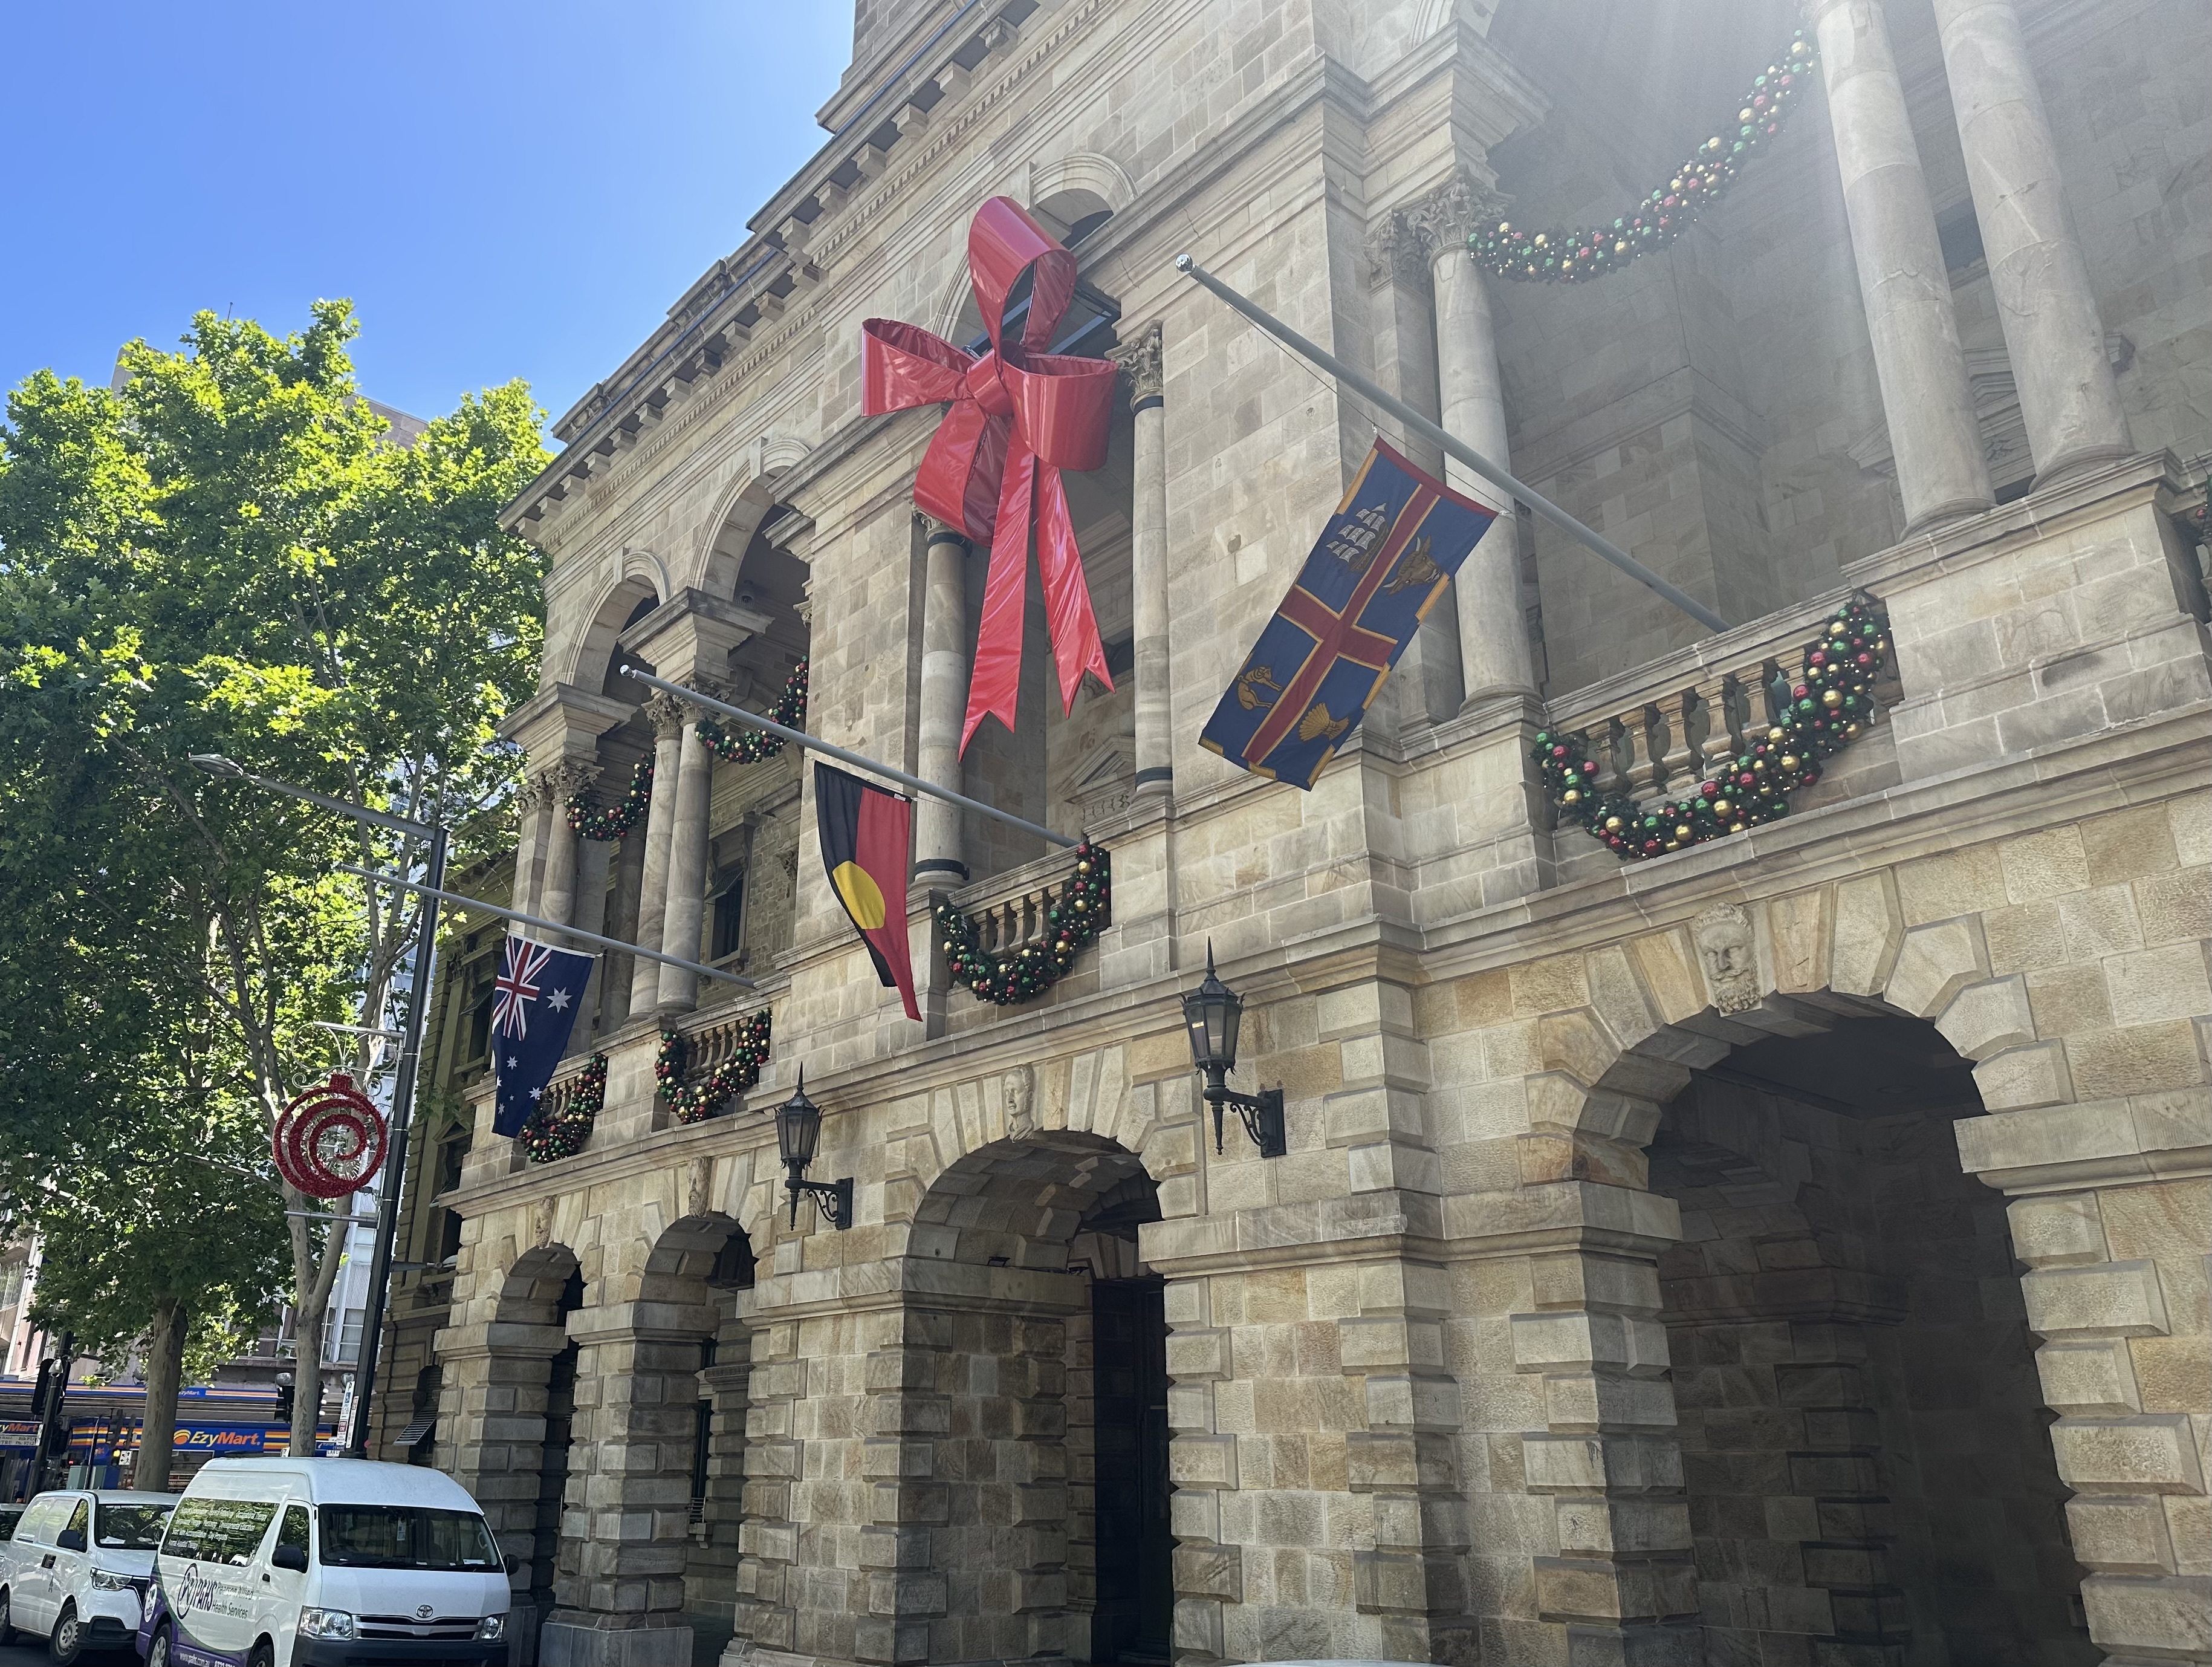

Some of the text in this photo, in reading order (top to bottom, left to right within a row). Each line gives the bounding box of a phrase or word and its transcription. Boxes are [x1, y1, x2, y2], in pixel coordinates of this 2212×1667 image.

[189, 1431, 259, 1448] EzyMart
[192, 1578, 218, 1612] PAHS
[216, 1581, 255, 1600] Pearson Allied
[212, 1599, 248, 1619] Health Services
